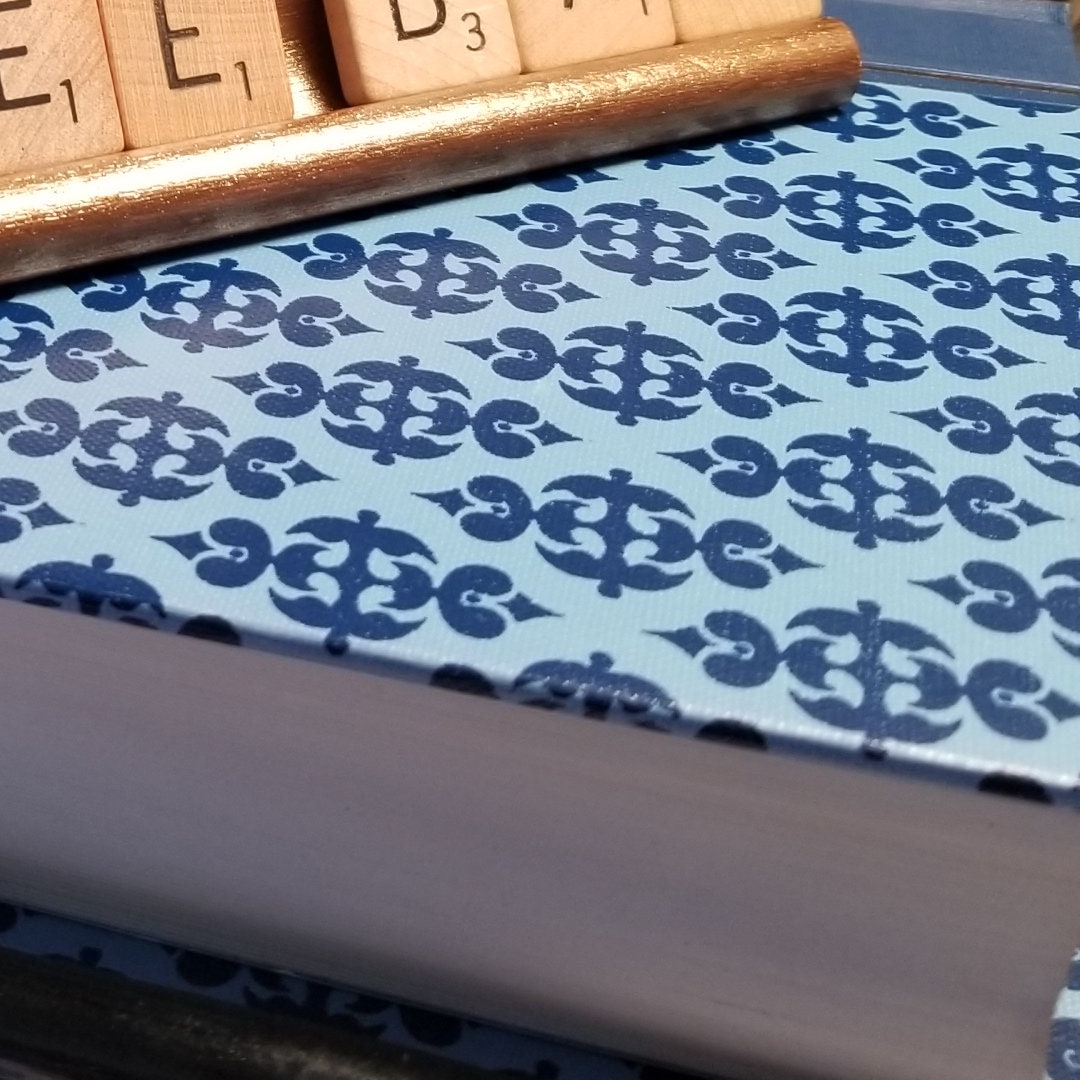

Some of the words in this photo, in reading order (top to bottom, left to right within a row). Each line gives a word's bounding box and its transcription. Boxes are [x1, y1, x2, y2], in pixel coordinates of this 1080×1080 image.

[461, 12, 487, 52] 3
[60, 78, 79, 124] 1
[234, 61, 253, 102] 1
